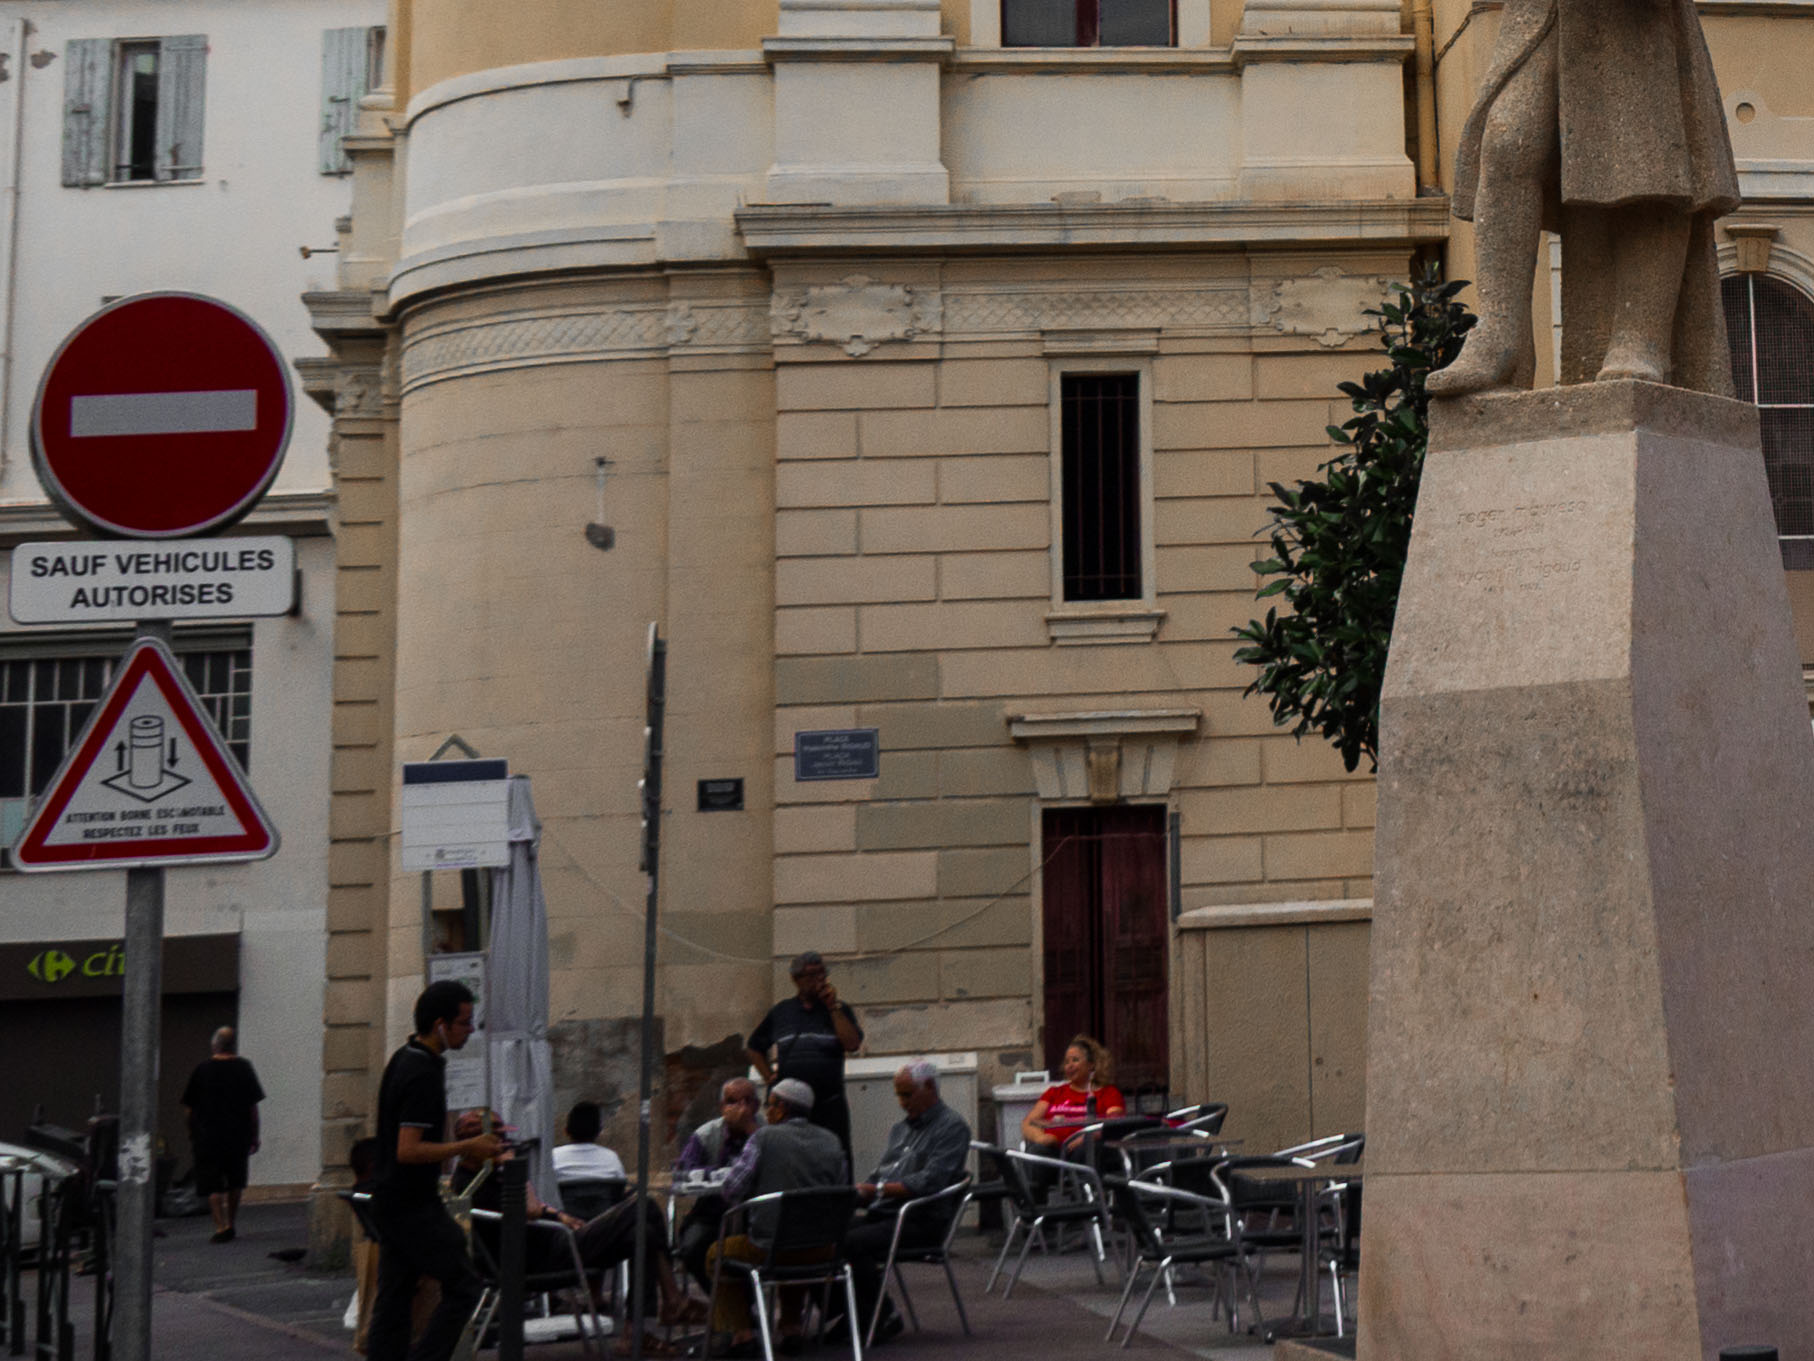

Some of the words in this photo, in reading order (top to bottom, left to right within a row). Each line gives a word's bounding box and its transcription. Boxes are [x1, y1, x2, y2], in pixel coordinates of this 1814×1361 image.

[30, 554, 107, 577] SAUF
[116, 549, 275, 575] VEHICULES
[70, 583, 234, 608] AUTORISES
[82, 825, 143, 839] RESPECTEZ
[148, 824, 168, 836] LES
[172, 823, 200, 835] FEUX
